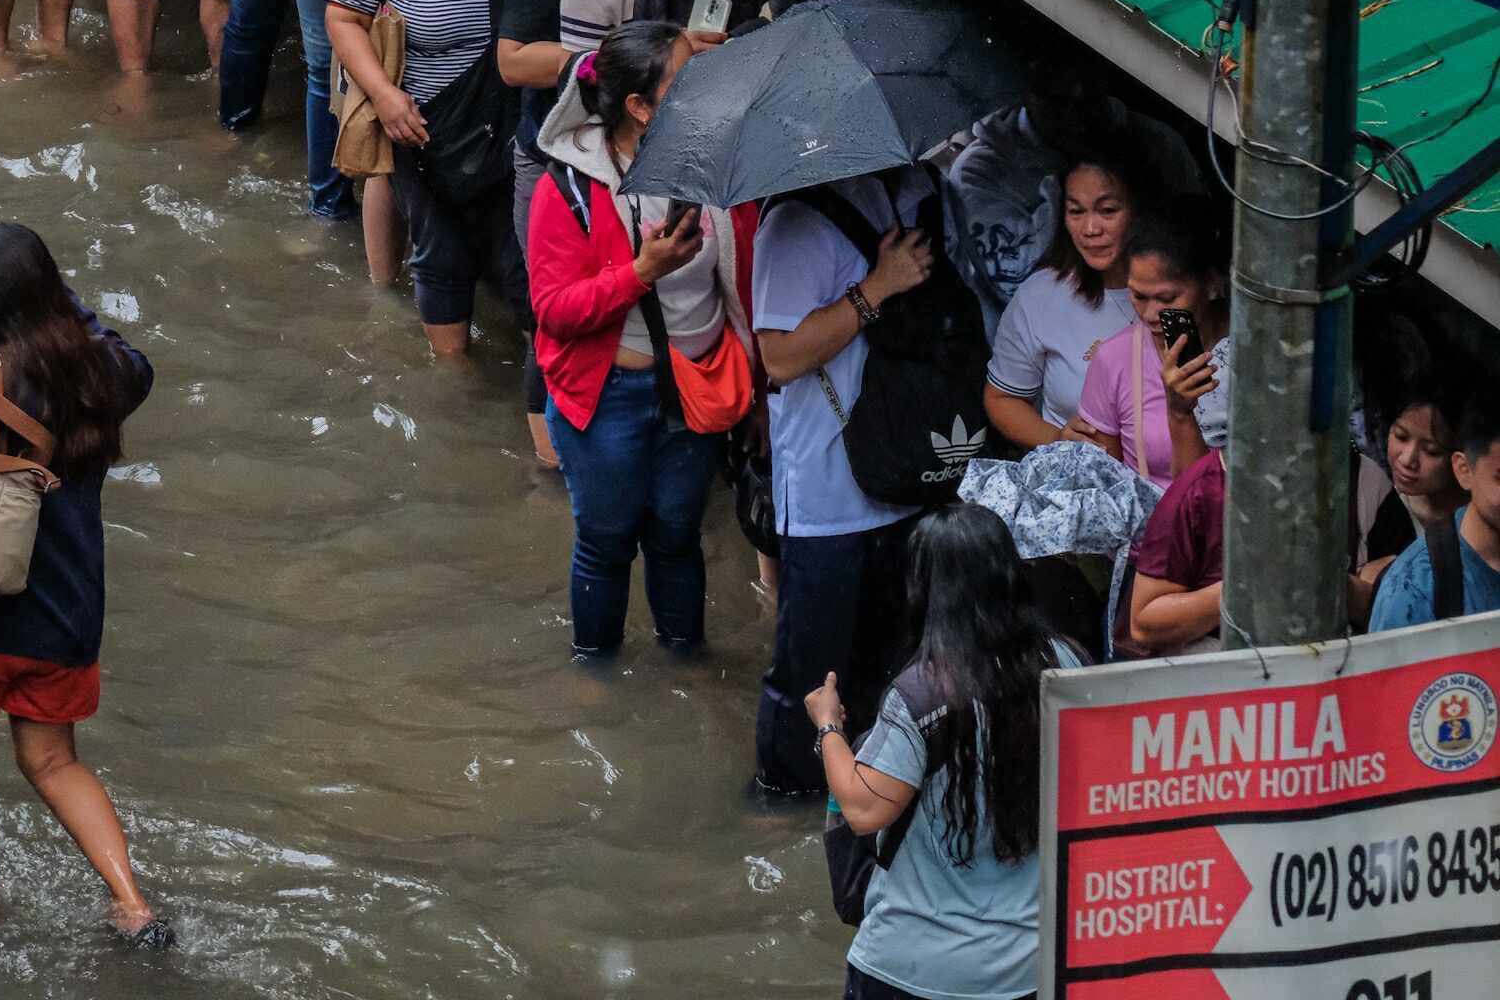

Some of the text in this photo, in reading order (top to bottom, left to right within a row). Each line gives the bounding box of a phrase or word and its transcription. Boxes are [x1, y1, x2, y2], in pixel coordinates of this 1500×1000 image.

[1131, 694, 1347, 775] MANILA
[1088, 752, 1386, 816] EMERGENCY HOTLINES
[1084, 858, 1217, 903] DISTRICT
[1269, 823, 1500, 928] (02) 8516 8435
[1074, 895, 1224, 940] HOSPITAL:
